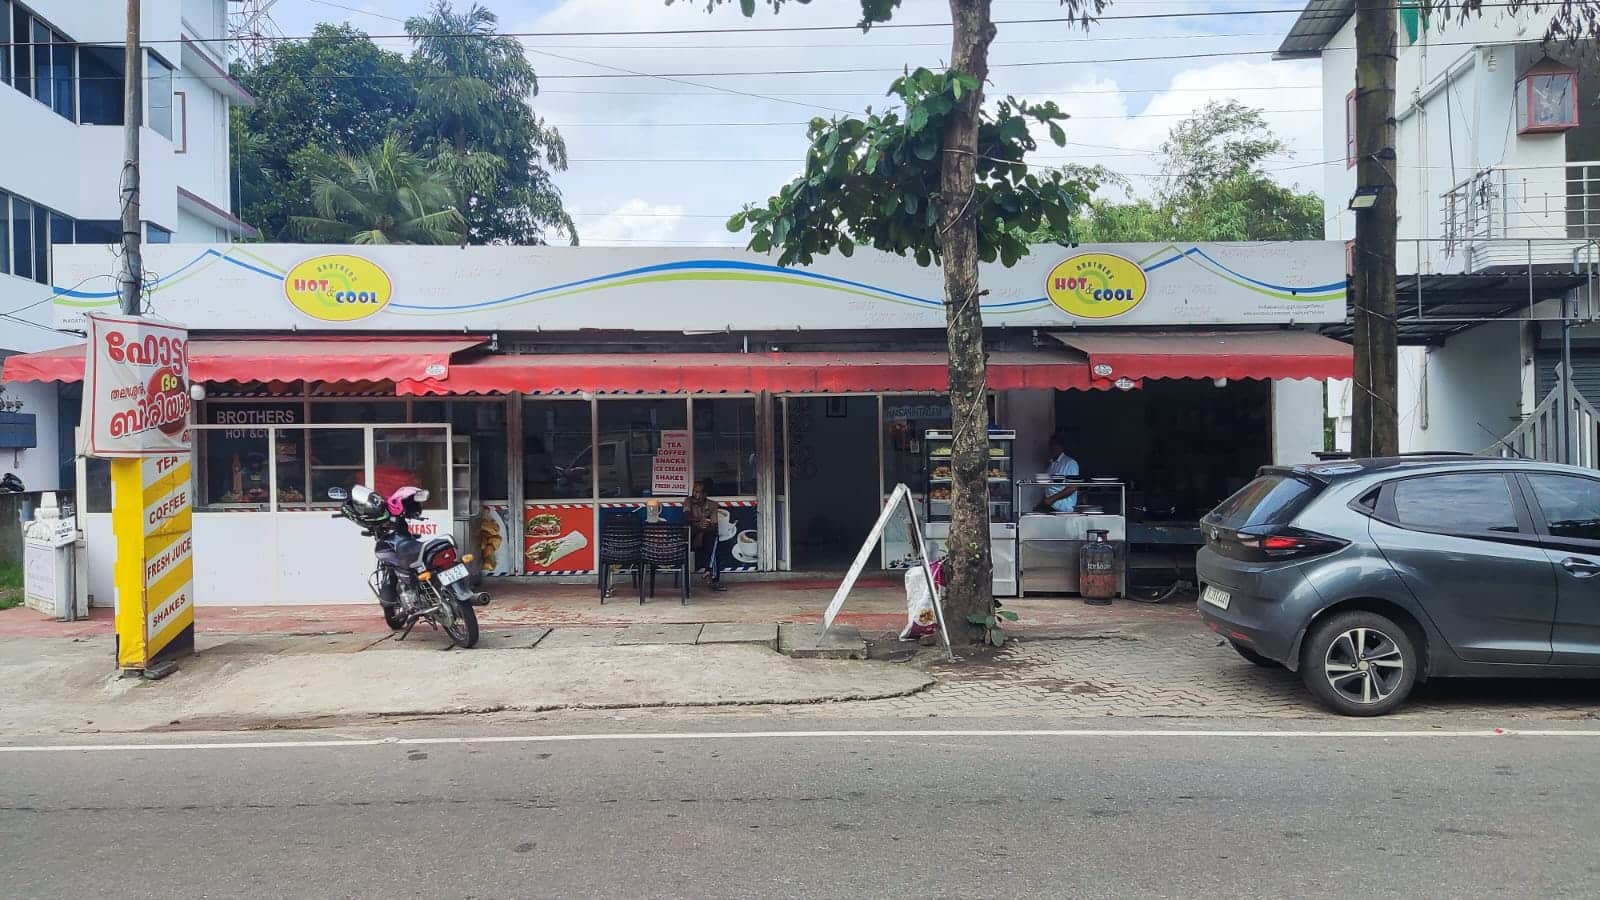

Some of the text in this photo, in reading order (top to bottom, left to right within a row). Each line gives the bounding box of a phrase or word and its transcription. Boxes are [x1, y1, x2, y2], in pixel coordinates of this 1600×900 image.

[317, 263, 358, 282] BROTHERS
[1076, 261, 1114, 279] BROTHERS
[294, 278, 378, 303] HOT & COOL
[1055, 277, 1134, 301] HOT & COOL
[217, 410, 295, 424] BROTHERS
[225, 428, 246, 439] HOT
[156, 456, 178, 473] TEA
[149, 492, 186, 525] COFFEE
[147, 537, 192, 580] FRESH JUICE
[153, 594, 186, 627] SHAKES
